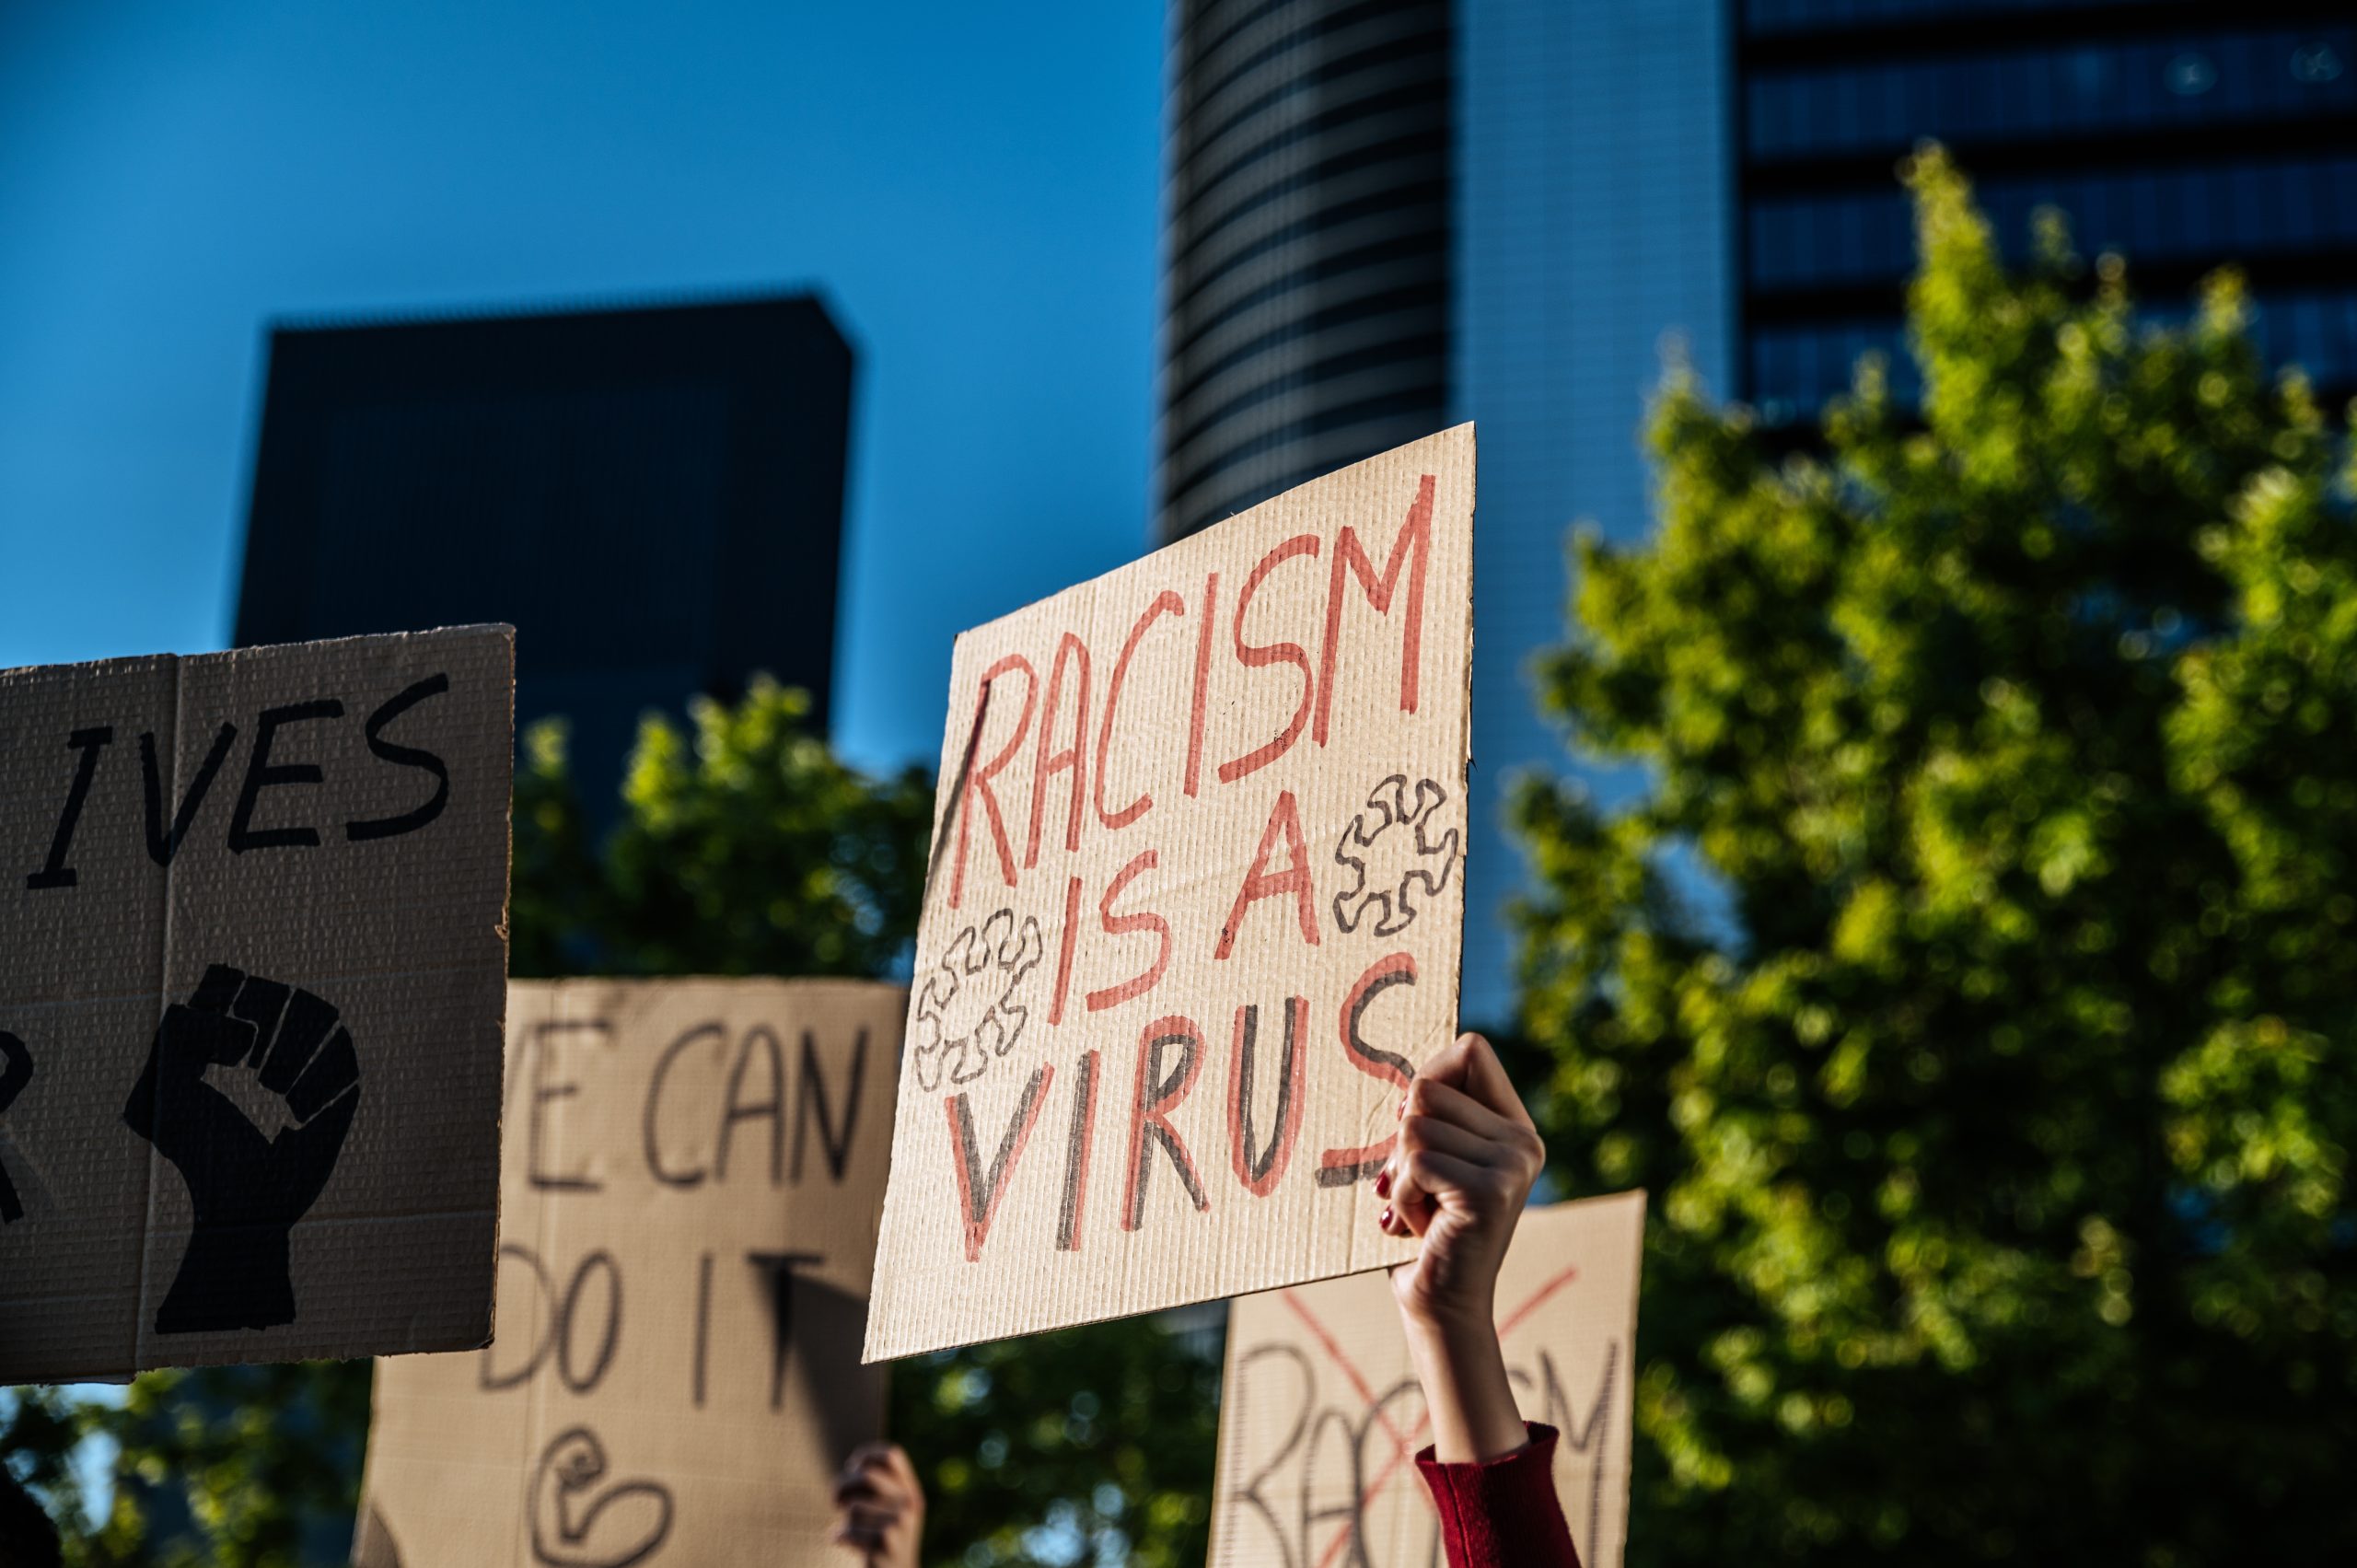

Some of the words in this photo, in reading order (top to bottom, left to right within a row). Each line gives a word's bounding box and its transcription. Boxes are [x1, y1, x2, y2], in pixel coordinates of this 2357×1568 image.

[948, 474, 1436, 910] RACISM
[1047, 849, 1172, 1027] IS
[1213, 790, 1320, 960] A
[505, 1019, 611, 1191] E
[643, 1019, 871, 1189] CAN
[946, 952, 1418, 1263] VIRUS
[478, 1243, 623, 1396] DO
[692, 1248, 826, 1411] IT
